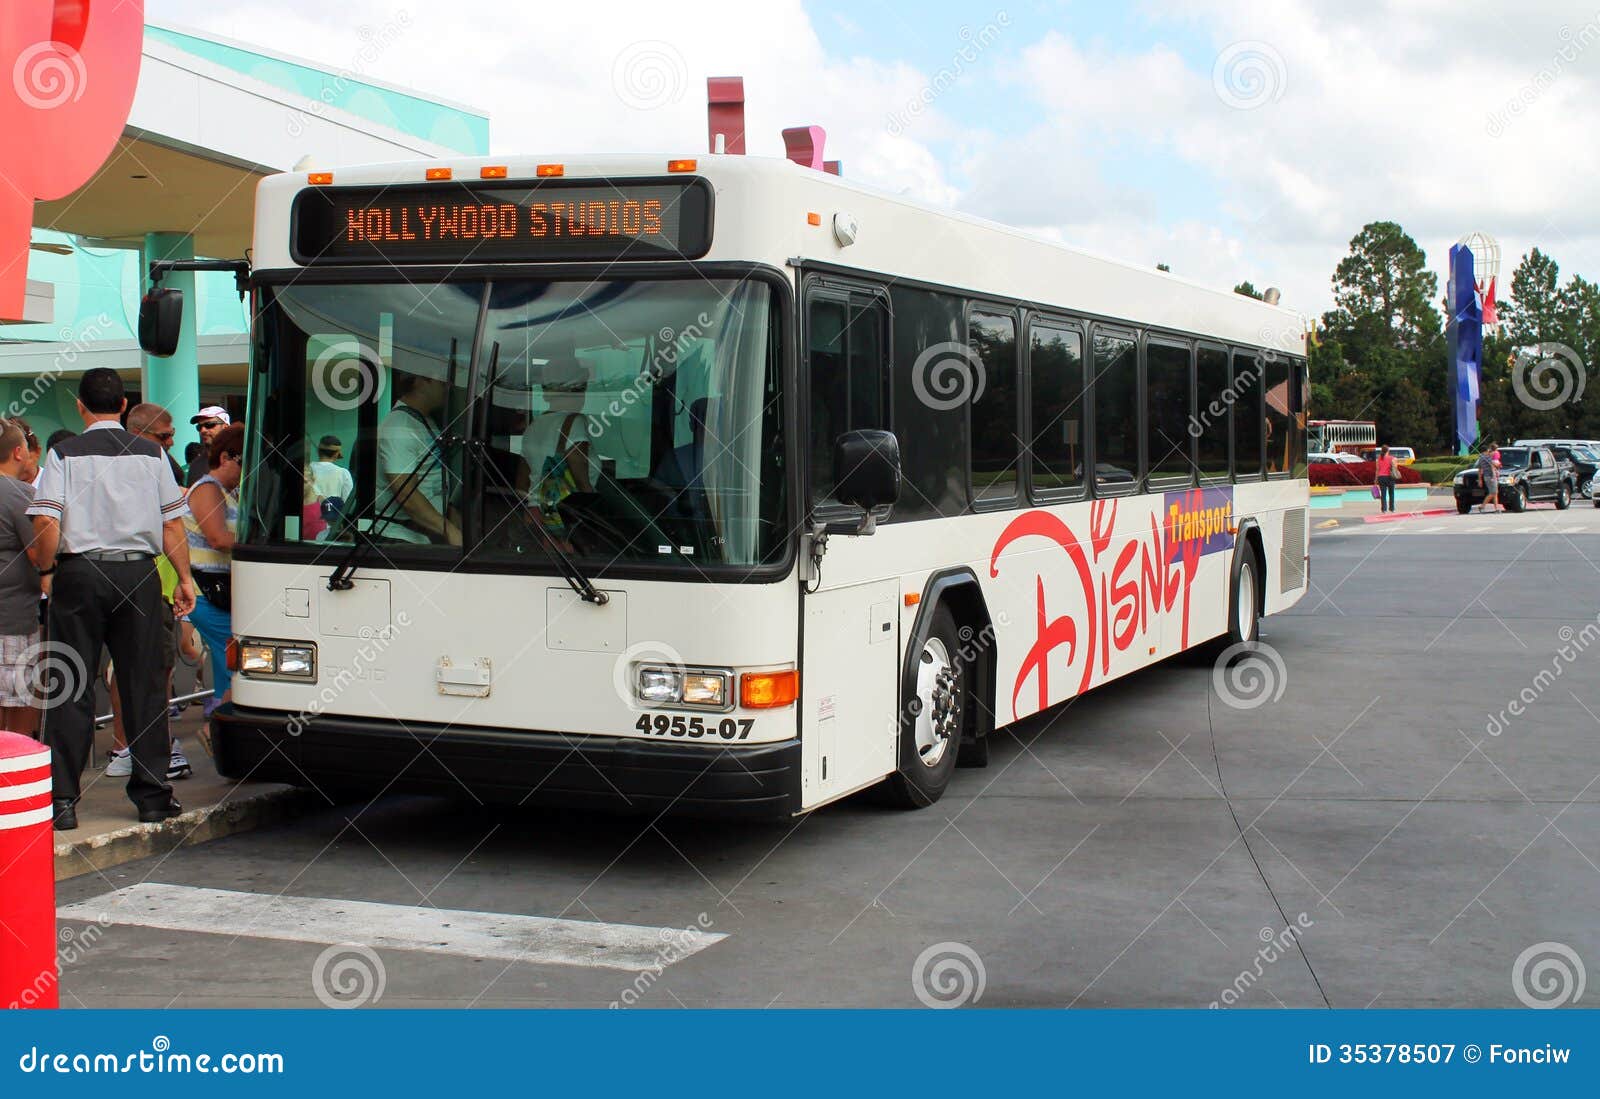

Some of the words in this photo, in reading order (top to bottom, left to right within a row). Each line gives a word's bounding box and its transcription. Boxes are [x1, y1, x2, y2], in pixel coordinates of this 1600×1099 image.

[346, 203, 518, 241] HOLLYWOOD
[530, 200, 662, 237] STUDIOS
[1169, 499, 1232, 544] Transport
[635, 713, 755, 740] 4955-07
